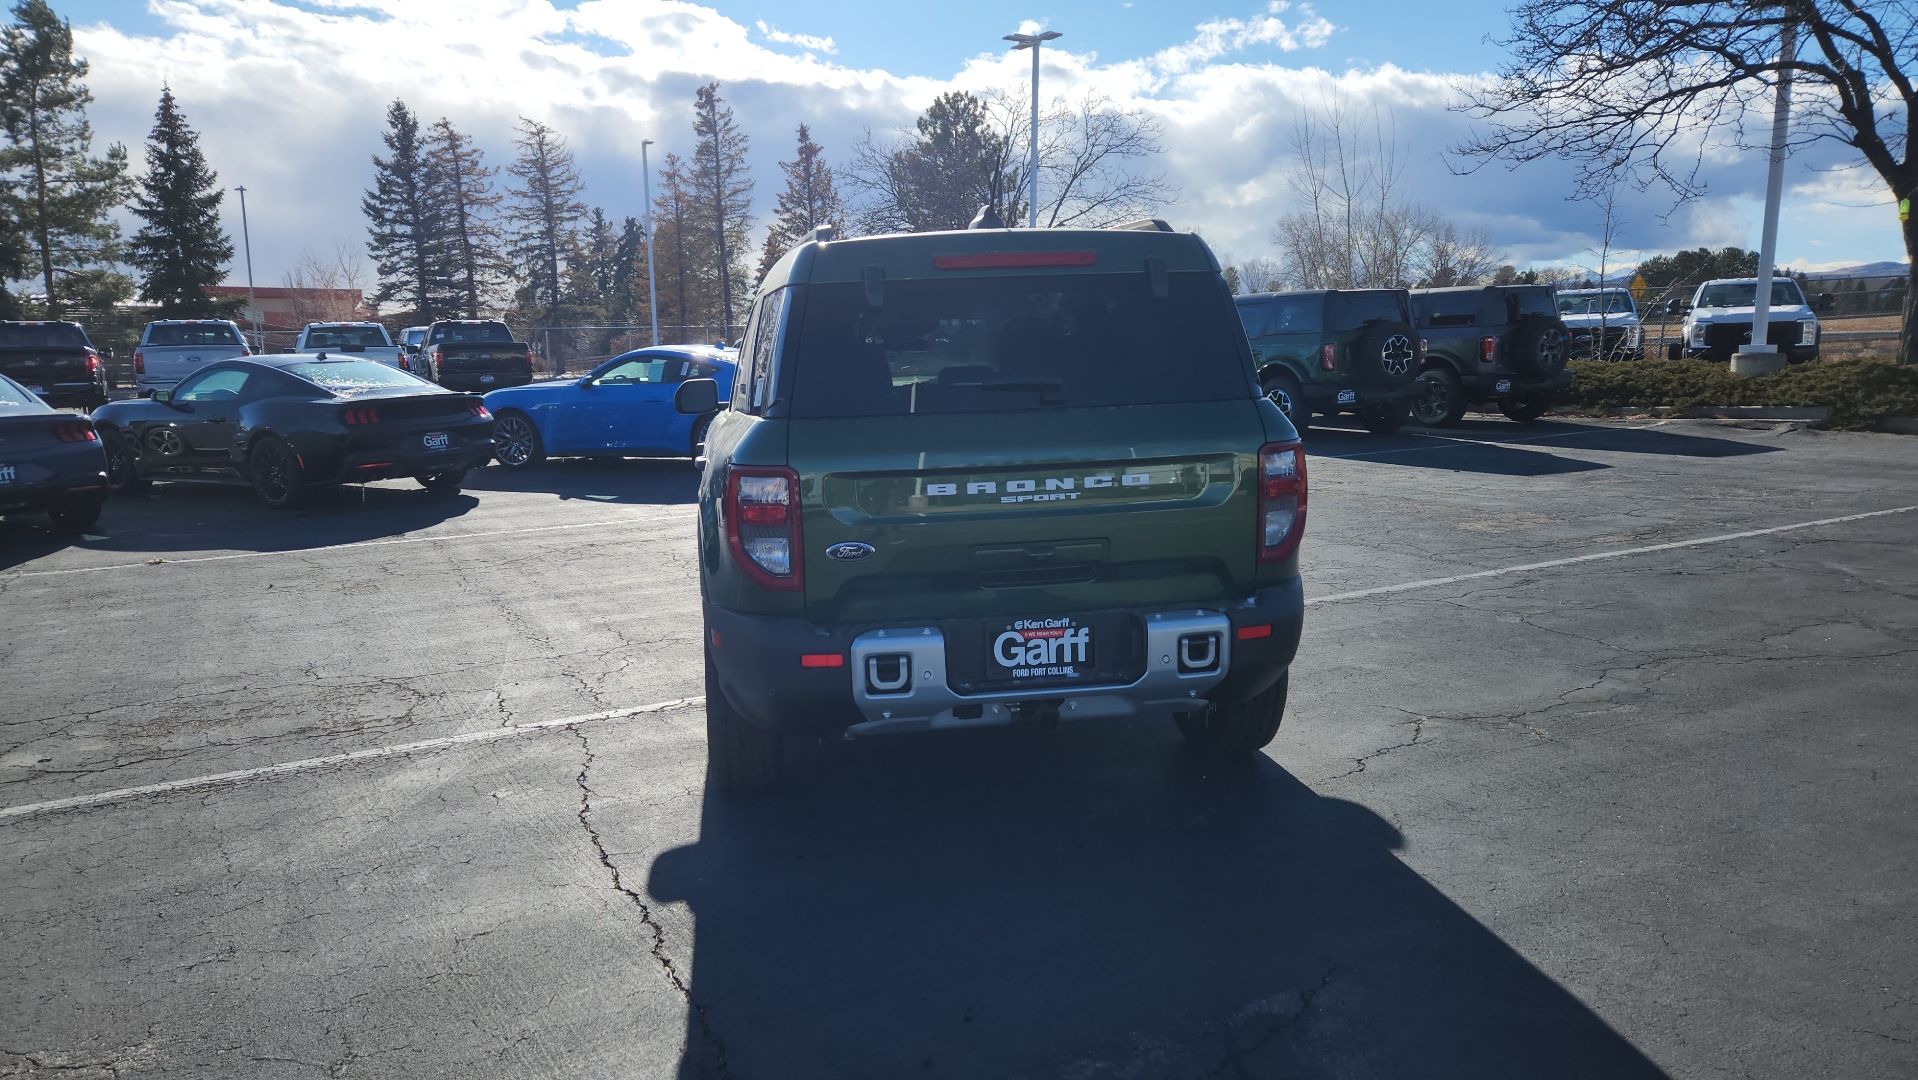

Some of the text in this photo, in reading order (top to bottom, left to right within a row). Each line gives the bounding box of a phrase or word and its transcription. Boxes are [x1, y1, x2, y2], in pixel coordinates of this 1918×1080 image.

[1338, 391, 1355, 400] Garff
[423, 434, 449, 447] Garff
[926, 473, 1150, 496] BRONCO
[1000, 492, 1081, 504] SPORT
[837, 546, 864, 557] Ford
[1023, 619, 1044, 629] Ken
[1044, 617, 1070, 628] Garff
[993, 627, 1089, 667] Garff
[1012, 665, 1074, 678] FORD FORT COLLINS
